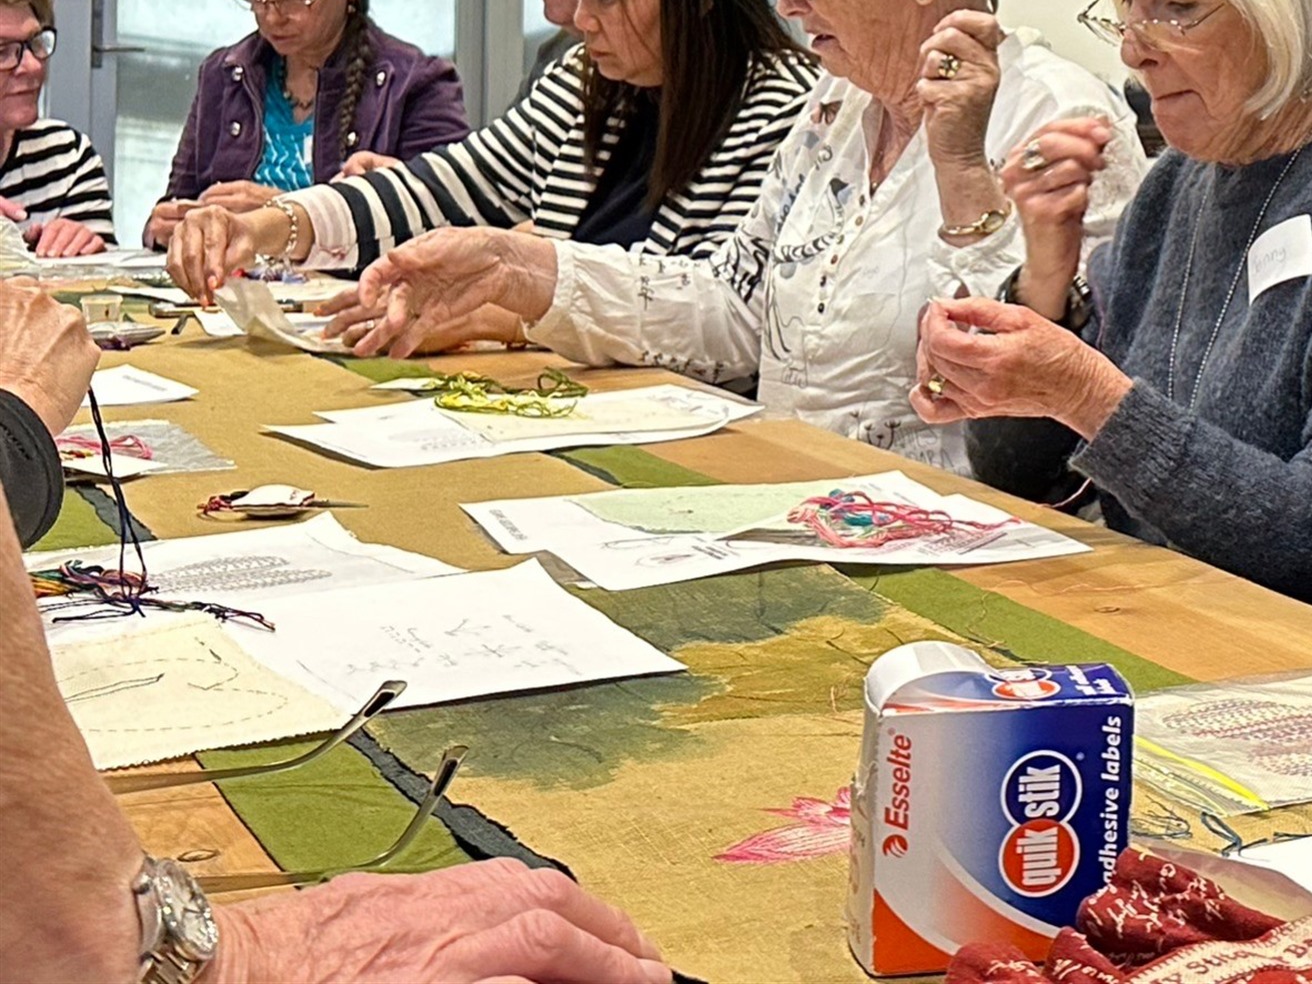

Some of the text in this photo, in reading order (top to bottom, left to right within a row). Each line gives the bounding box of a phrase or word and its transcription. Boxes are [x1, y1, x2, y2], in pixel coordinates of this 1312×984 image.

[884, 734, 912, 831] Esselte
[1101, 715, 1122, 783] labels
[1016, 764, 1062, 886] quik stik
